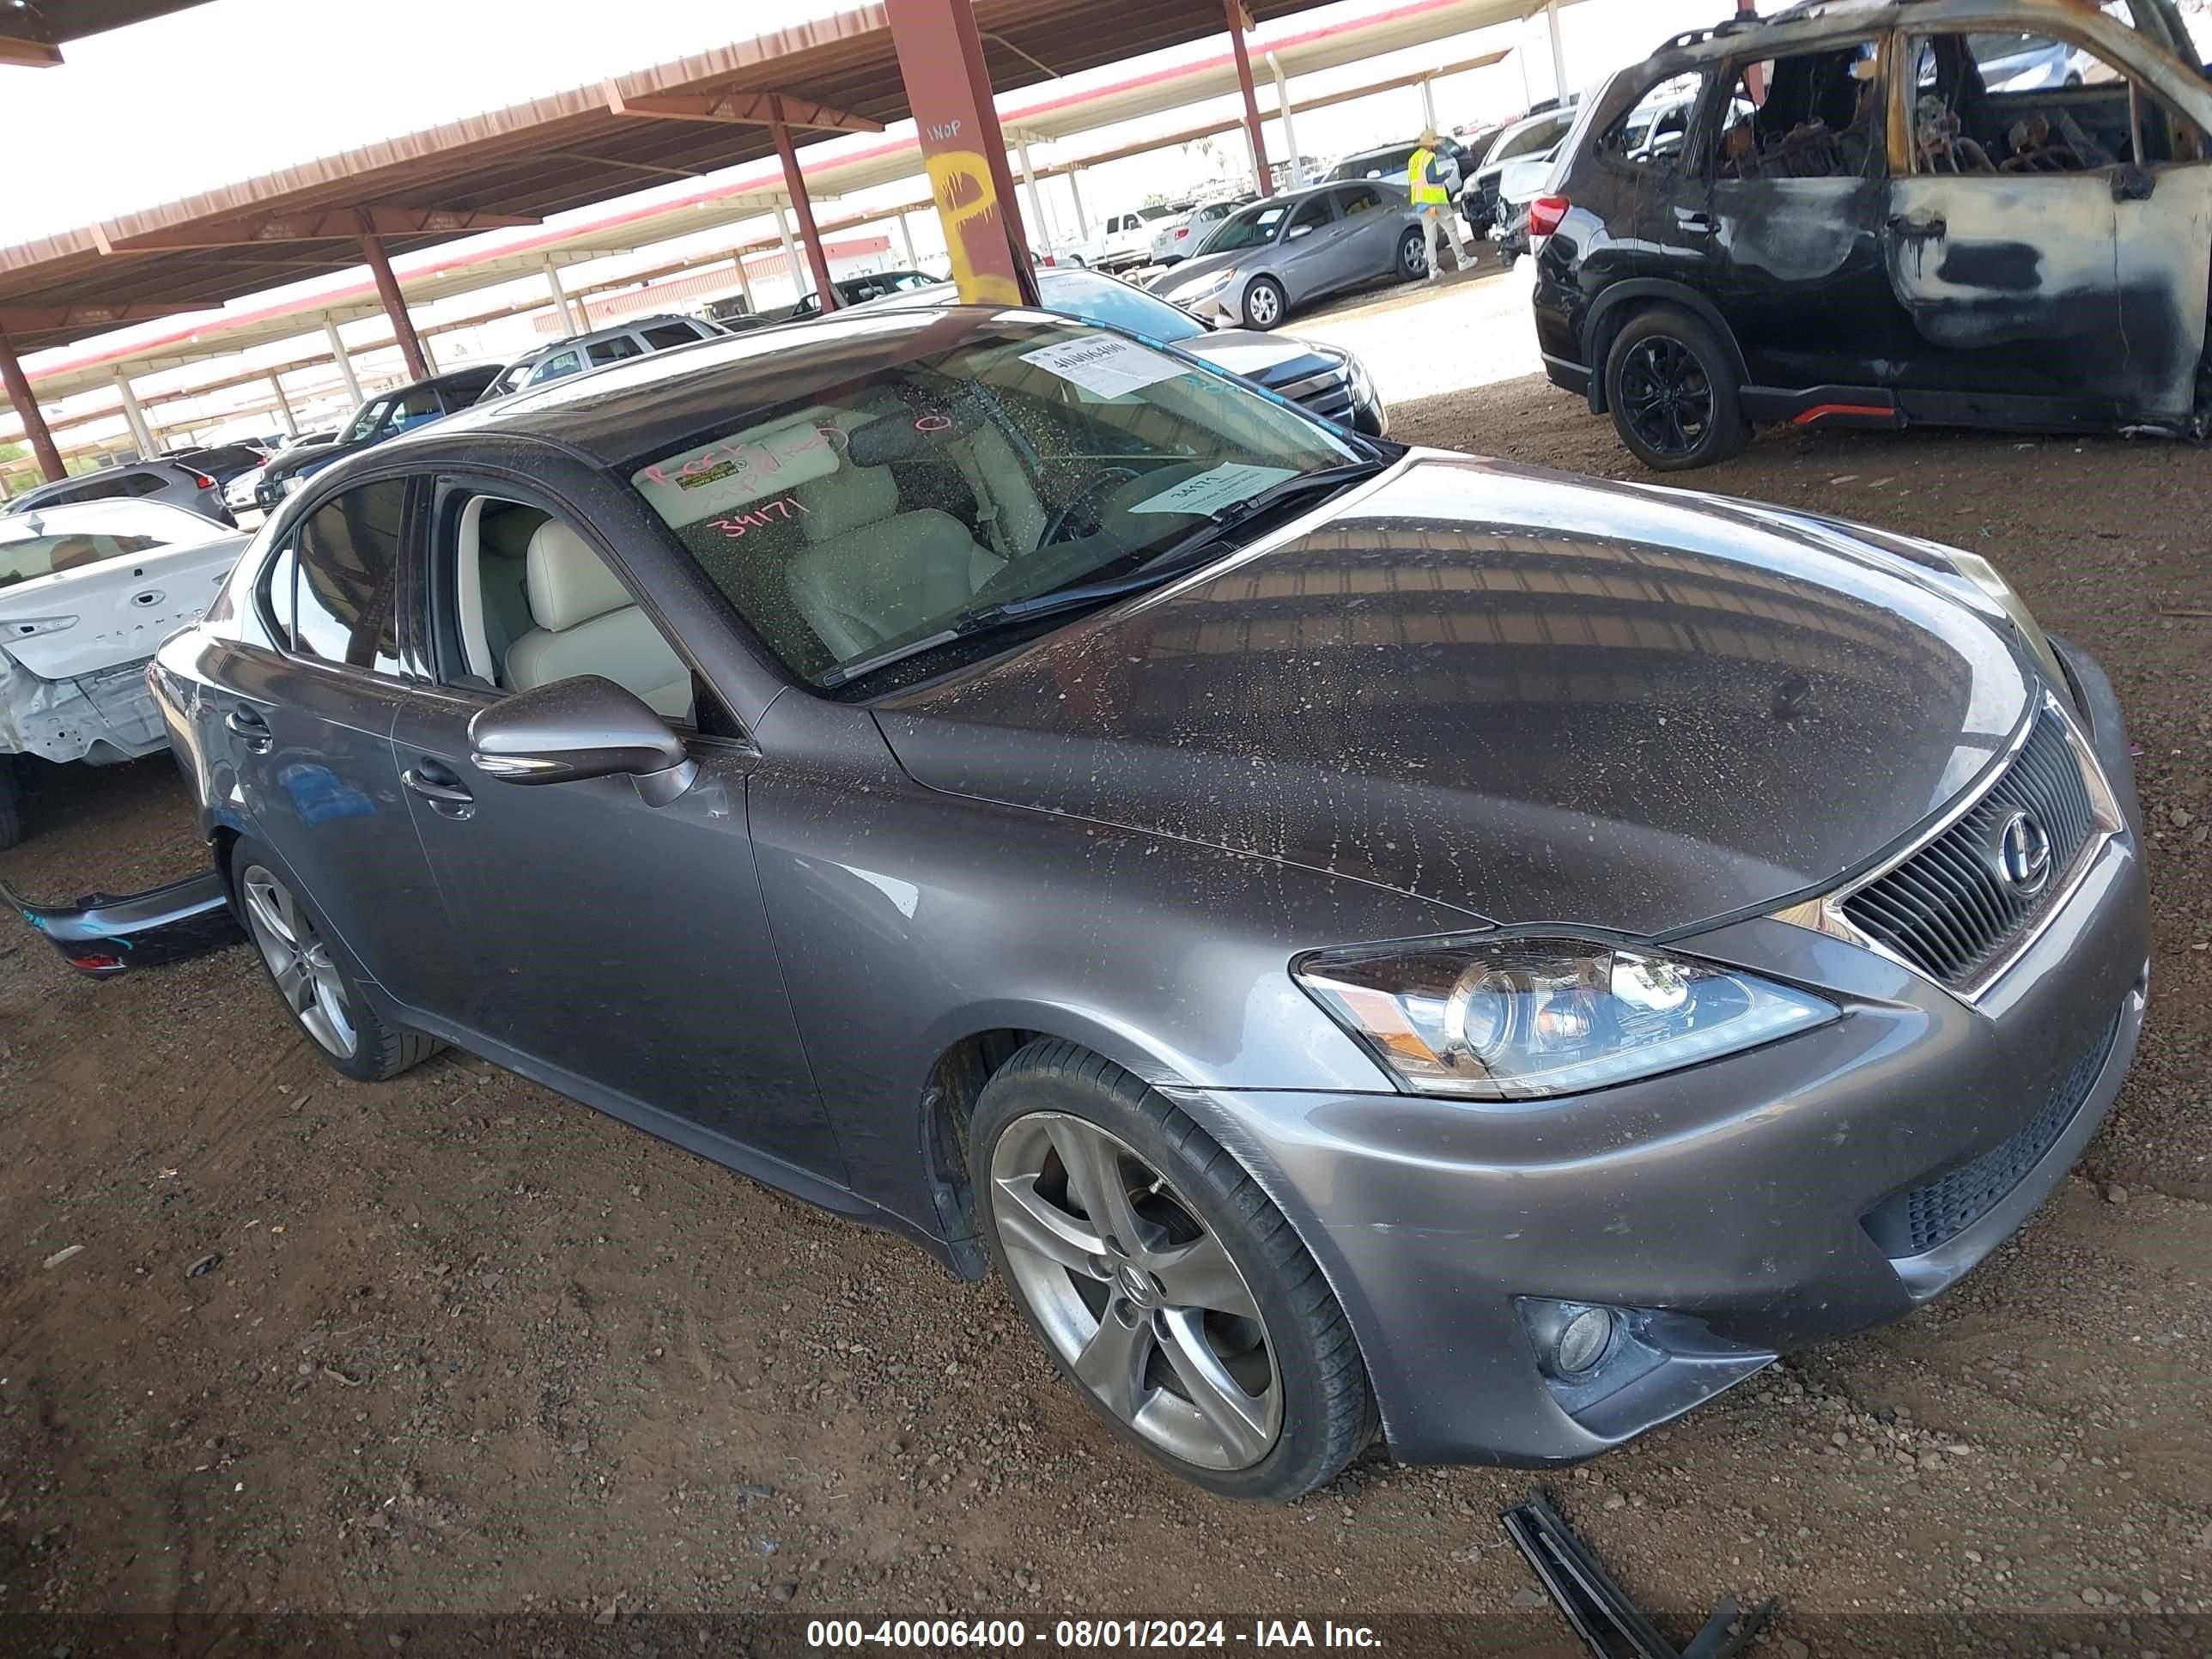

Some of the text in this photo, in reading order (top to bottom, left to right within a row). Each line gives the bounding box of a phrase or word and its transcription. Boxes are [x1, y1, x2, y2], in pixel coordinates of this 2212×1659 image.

[927, 119, 962, 143] INOP
[1053, 343, 1127, 368] 40006400
[706, 497, 811, 538] 34171
